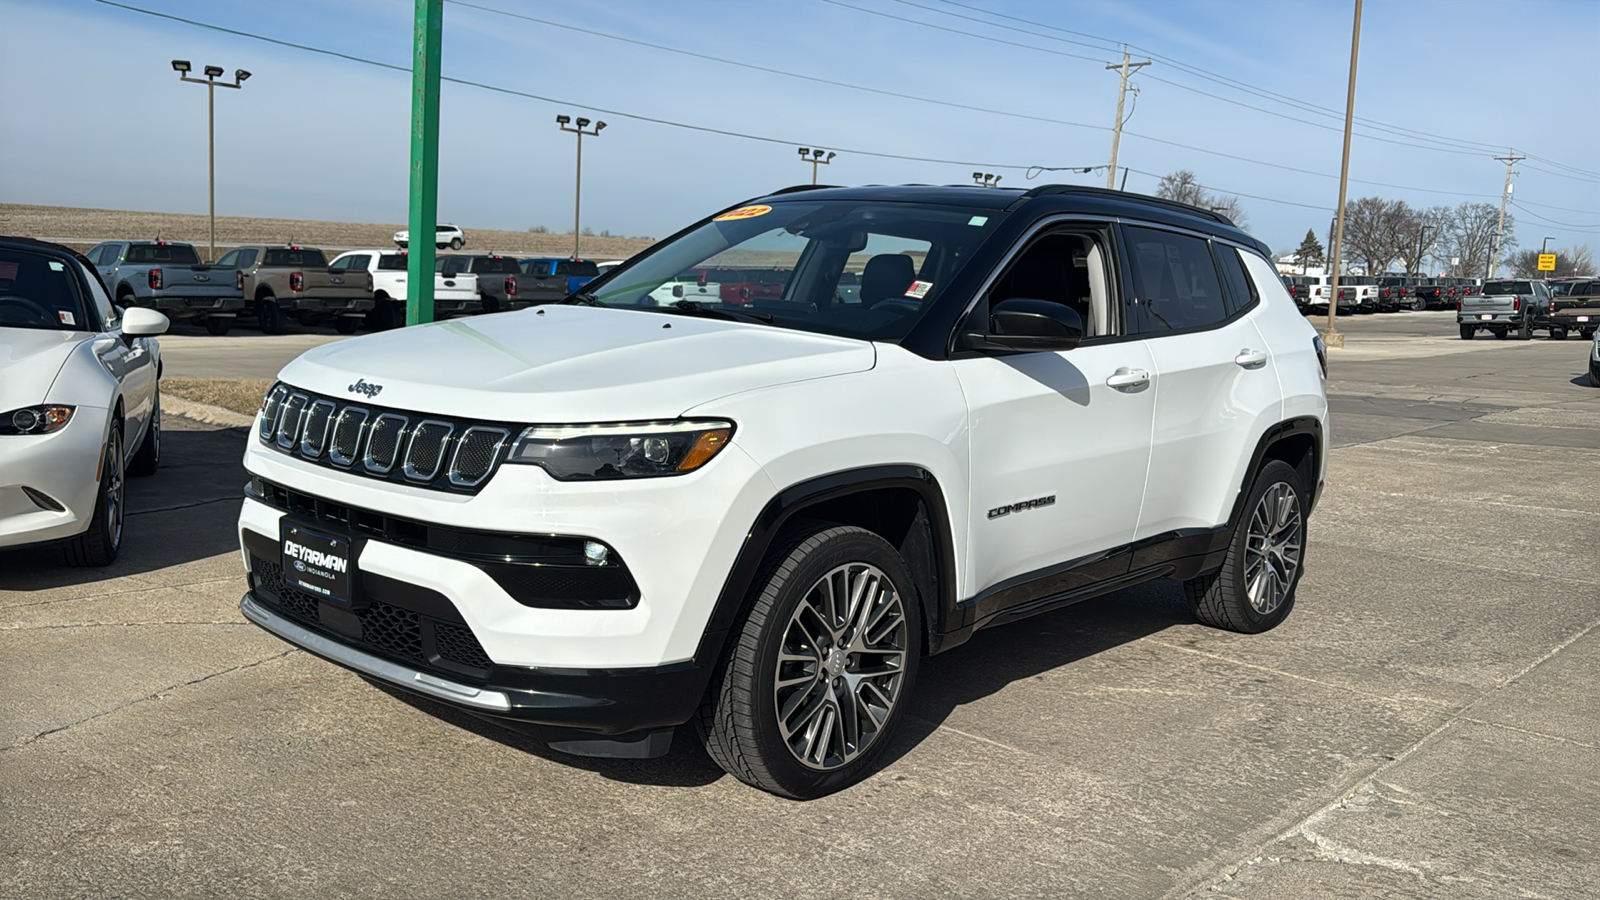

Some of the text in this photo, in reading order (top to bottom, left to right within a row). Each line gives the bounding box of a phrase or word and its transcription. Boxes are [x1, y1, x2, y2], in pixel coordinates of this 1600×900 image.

[348, 378, 383, 399] Jeep
[987, 495, 1056, 520] COMPASS
[284, 540, 348, 573] DEYARMAN
[306, 566, 336, 580] INDIANOLA
